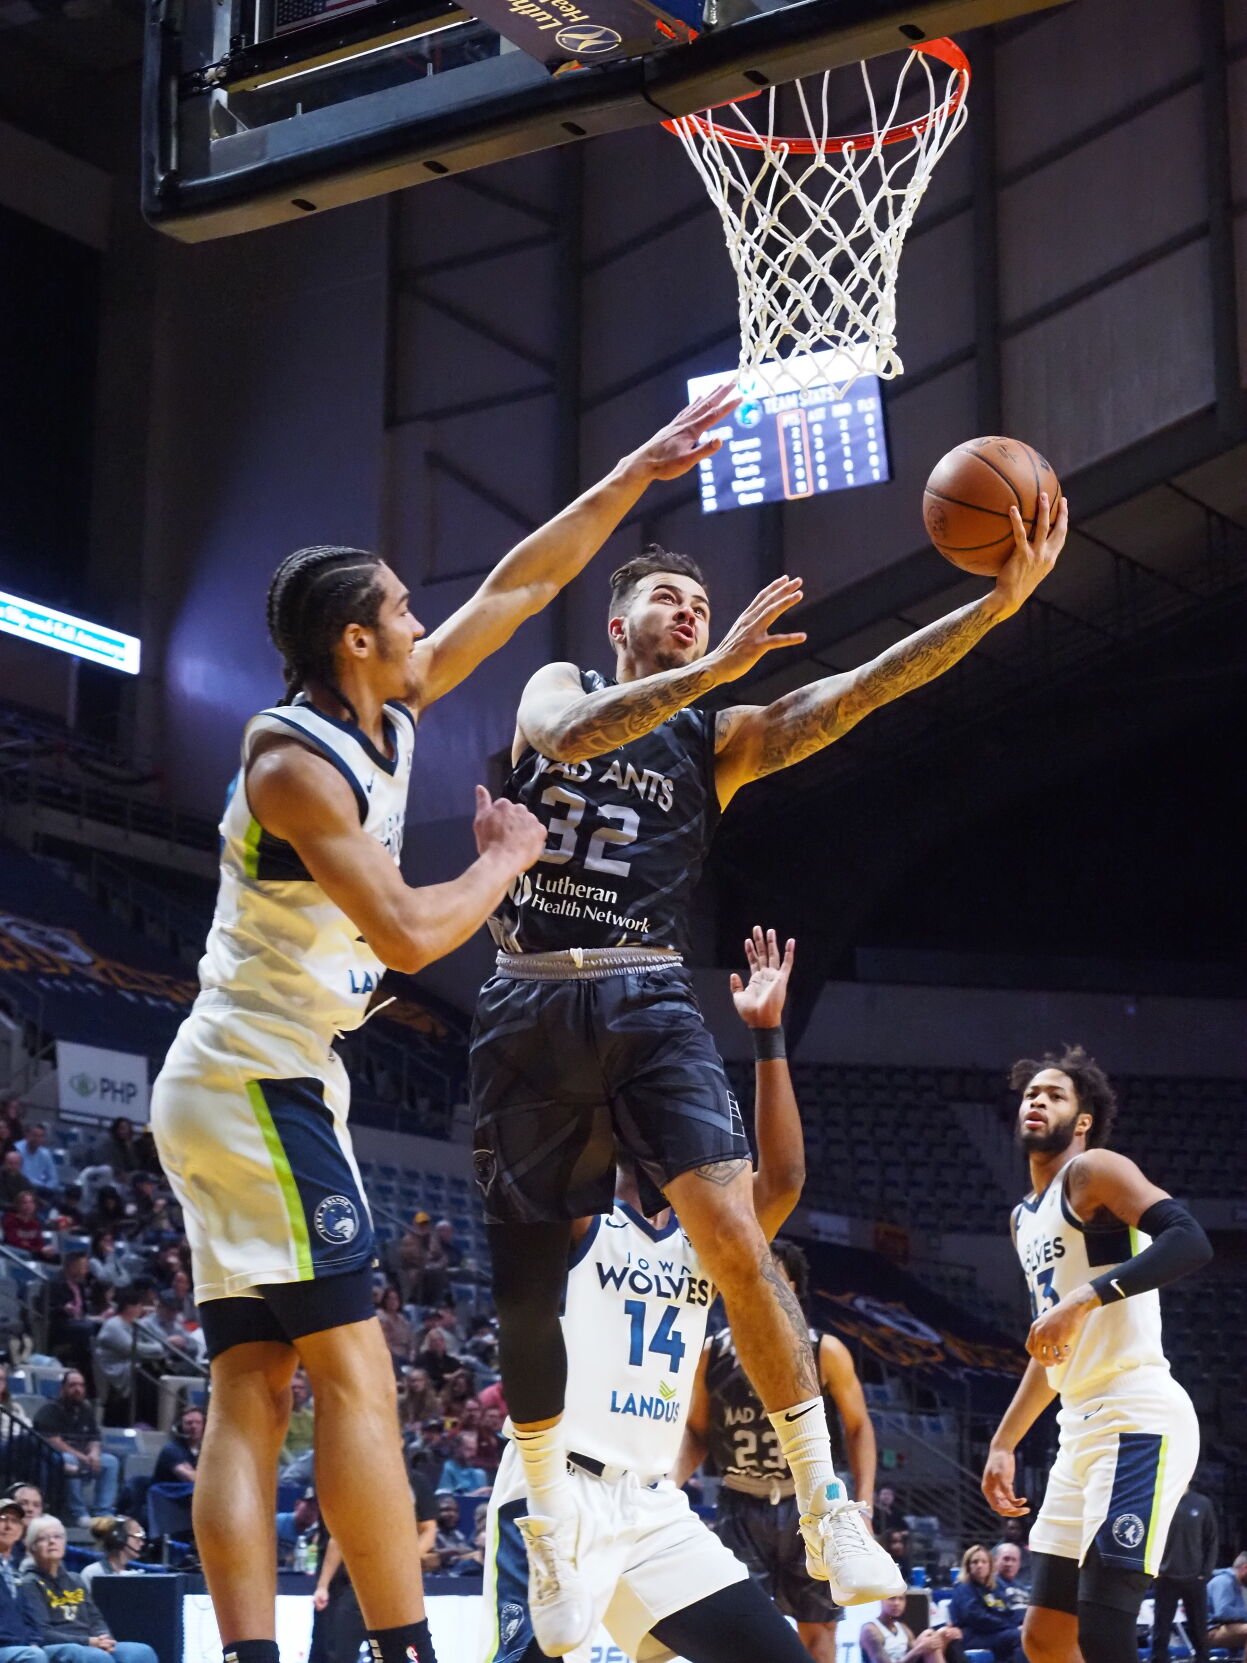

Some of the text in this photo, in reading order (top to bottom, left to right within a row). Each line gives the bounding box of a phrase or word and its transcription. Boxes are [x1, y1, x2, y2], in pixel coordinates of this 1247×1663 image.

[599, 759, 674, 812] ANTS
[536, 786, 640, 878] 32
[535, 873, 618, 904] Lutheran
[531, 893, 651, 934] Health Network
[100, 1077, 138, 1104] PHP
[627, 1252, 692, 1276] IOWA
[596, 1262, 708, 1307] WOLVES
[624, 1299, 686, 1374] 14
[610, 1390, 680, 1423] LANDUS
[733, 1429, 787, 1469] 23
